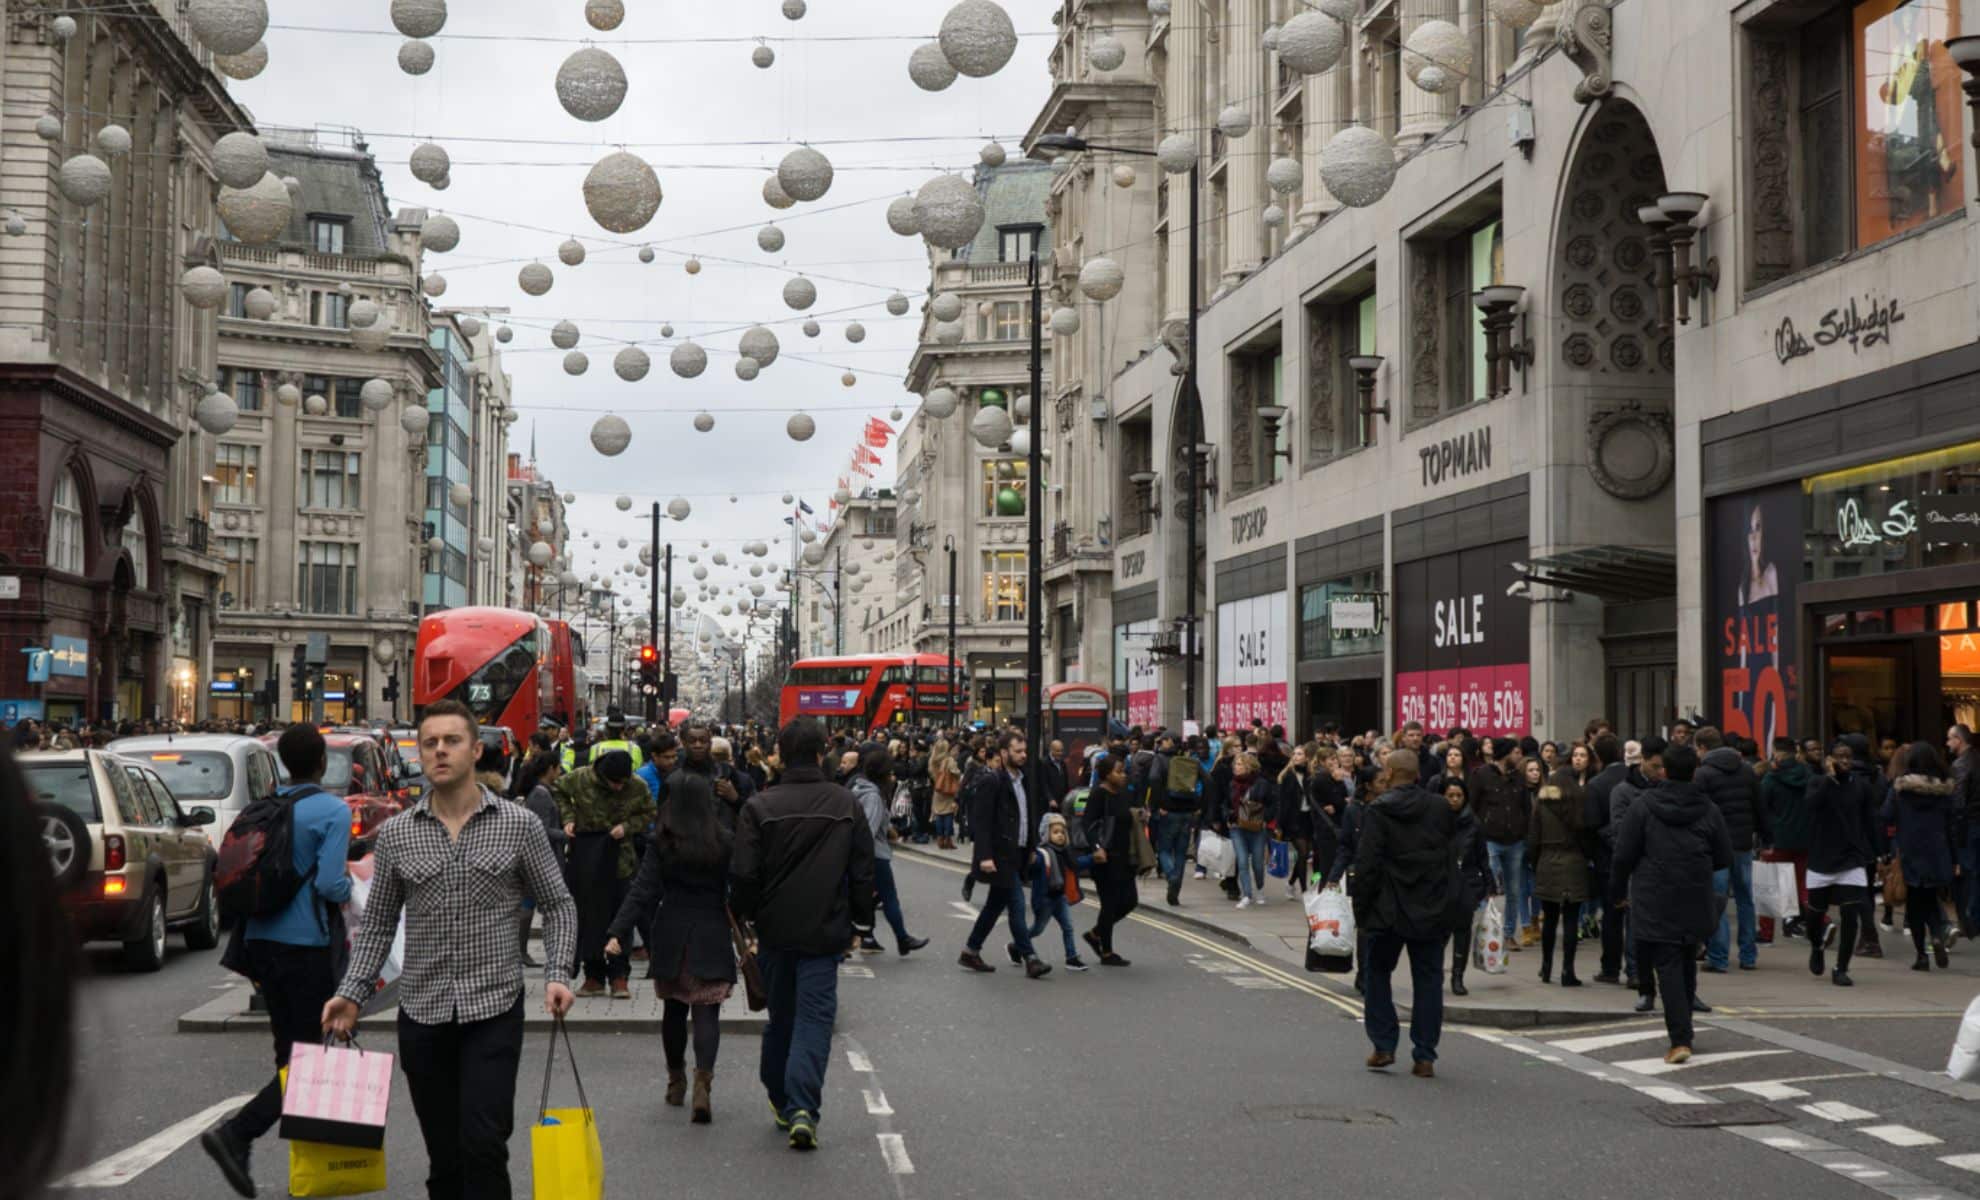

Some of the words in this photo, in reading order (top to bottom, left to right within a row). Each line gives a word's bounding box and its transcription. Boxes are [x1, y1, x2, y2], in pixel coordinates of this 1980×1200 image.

[1775, 316, 1815, 366] Miss
[1814, 293, 1905, 355] Selfridge
[1418, 423, 1492, 488] TOPMAN
[1231, 506, 1268, 545] TOPSHOP
[1837, 498, 1882, 549] Miss
[1121, 550, 1146, 579] TOPSHOP
[1434, 593, 1484, 649] SALE
[1724, 613, 1778, 657] SALE
[1239, 629, 1266, 668] SALE
[470, 685, 490, 701] 73
[1430, 693, 1455, 729] 50%
[1460, 692, 1488, 729] 50%
[1493, 690, 1524, 729] 50%
